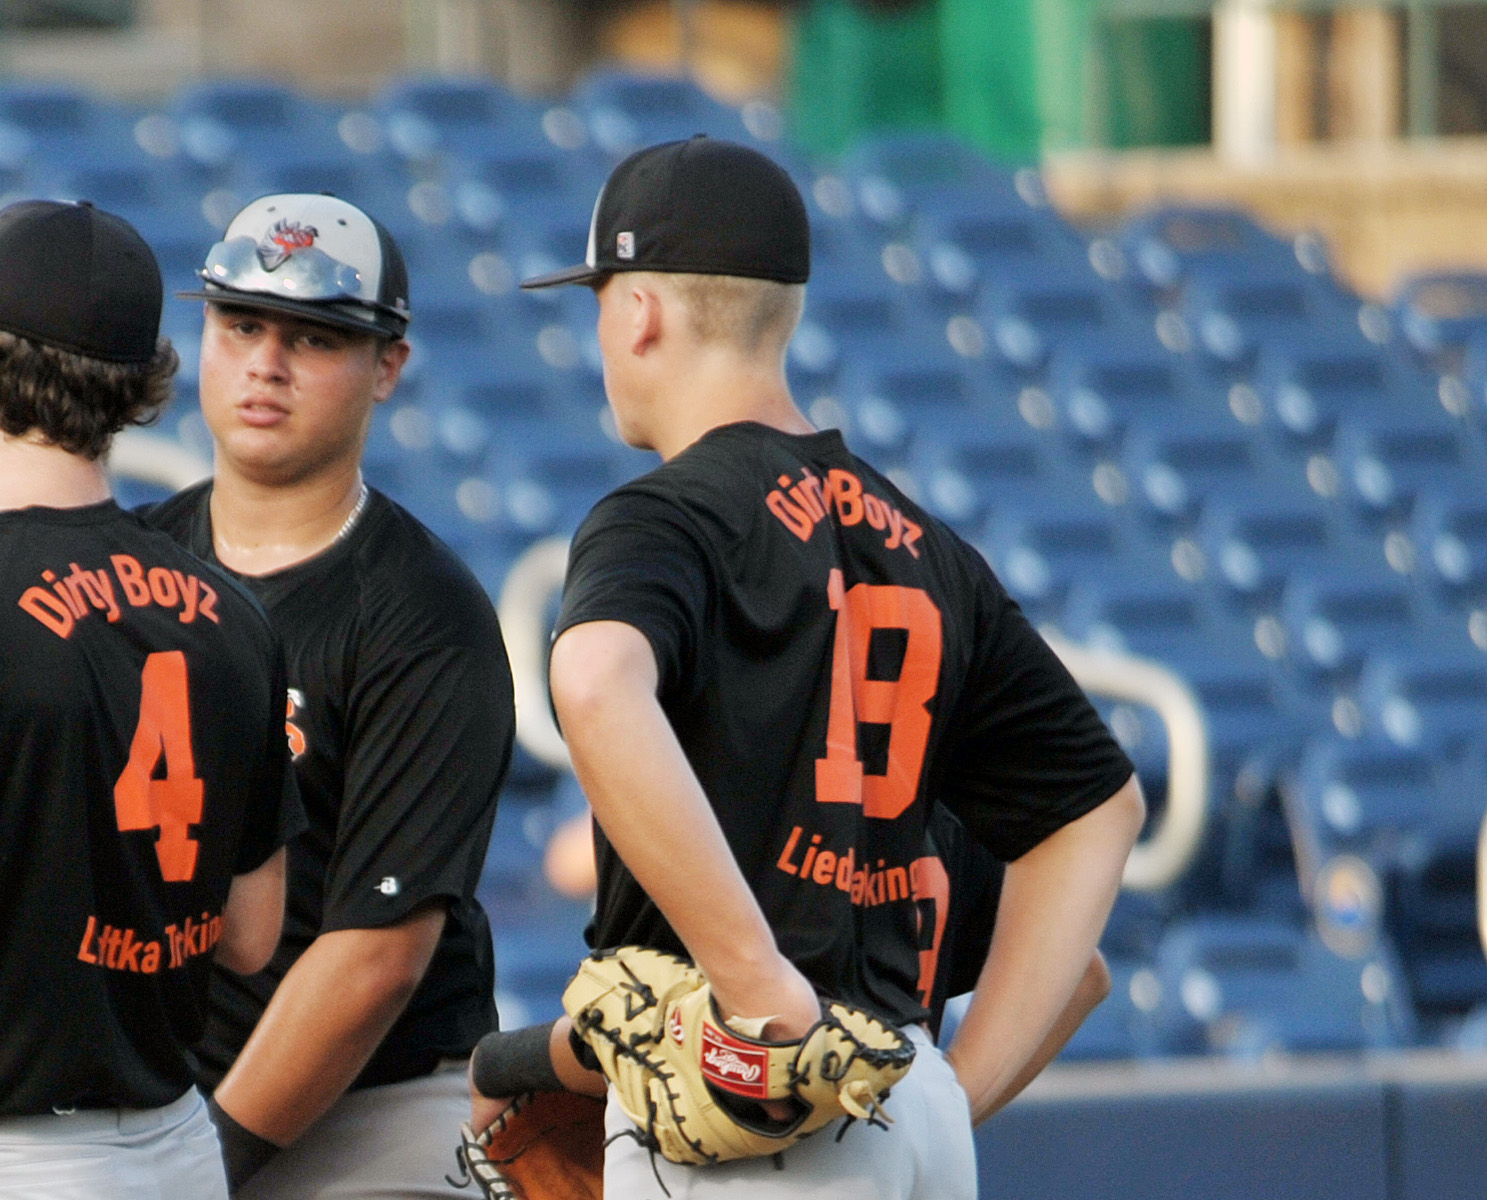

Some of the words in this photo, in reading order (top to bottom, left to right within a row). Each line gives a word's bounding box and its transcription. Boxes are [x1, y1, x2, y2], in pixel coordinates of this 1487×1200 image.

[829, 468, 924, 560] Boyz
[18, 562, 122, 640] Dirty
[110, 554, 221, 625] Boyz
[114, 650, 204, 882] 4
